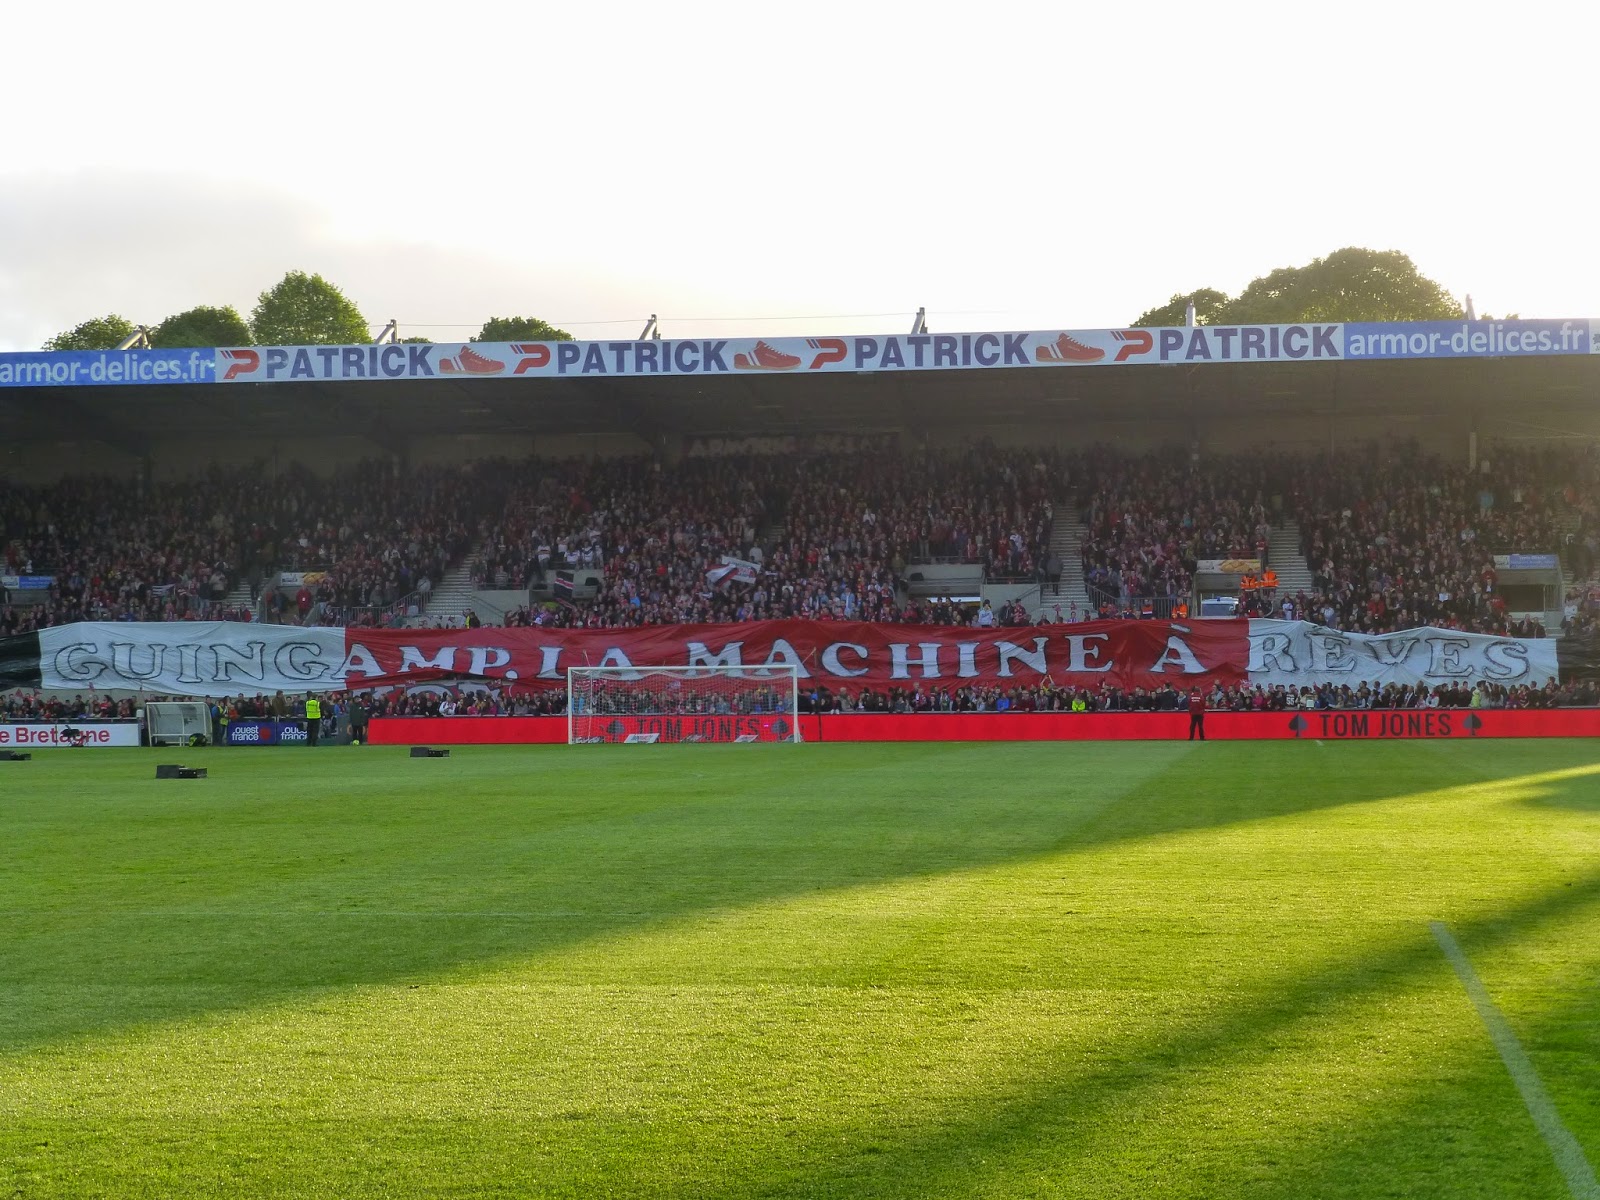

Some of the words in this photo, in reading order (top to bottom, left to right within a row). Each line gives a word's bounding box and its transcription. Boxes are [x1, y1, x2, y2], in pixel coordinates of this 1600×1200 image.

[854, 333, 1030, 369] PATRICK
[1159, 325, 1340, 360] PATRICK
[1349, 321, 1584, 355] armor-delices.fr
[0, 351, 211, 382] armor-delices.fr
[266, 346, 434, 378] PATRICK
[557, 341, 729, 373] PATRICK
[686, 633, 1114, 679] MACHINE
[232, 732, 258, 740] france
[235, 726, 258, 734] ouest
[637, 718, 682, 742] TOM
[690, 717, 760, 742] JONES
[1319, 714, 1369, 737] TOM
[1379, 713, 1452, 737] JONES
